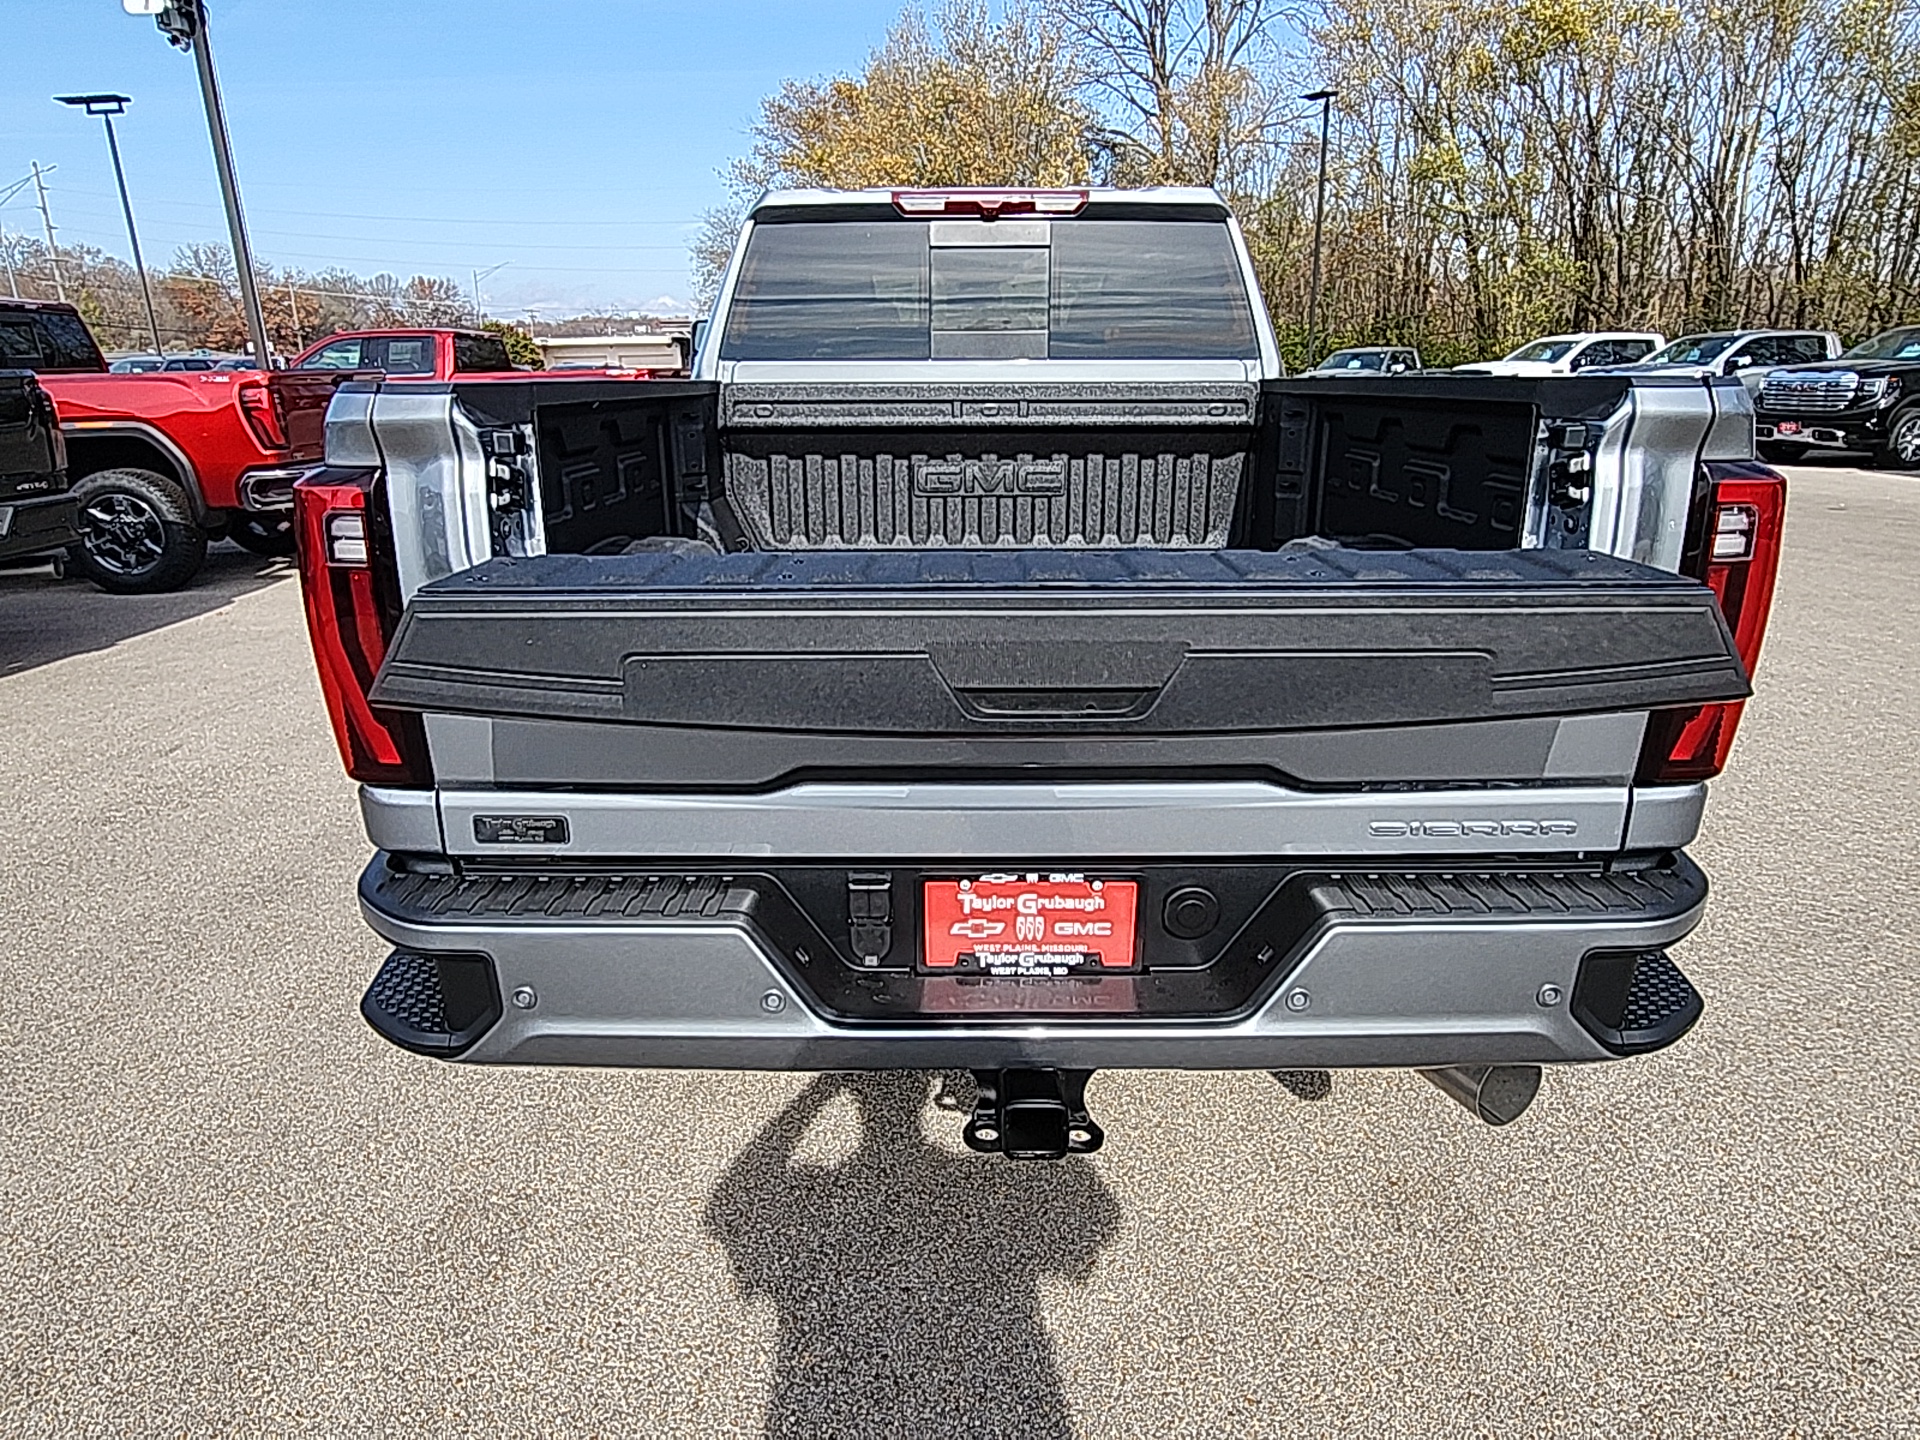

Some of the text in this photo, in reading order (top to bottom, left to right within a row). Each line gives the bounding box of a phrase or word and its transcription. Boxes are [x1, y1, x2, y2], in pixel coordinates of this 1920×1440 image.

[917, 464, 1065, 494] GMC
[1369, 820, 1577, 836] SIERRA
[1049, 873, 1084, 883] GMC
[957, 893, 1105, 914] Taylor Grubaugh
[1054, 922, 1112, 936] GMC
[973, 944, 1001, 952] WEST
[1041, 944, 1087, 953] MISSOURI
[975, 952, 1084, 967] Taylor Grubaugh
[990, 967, 1016, 975] WEST
